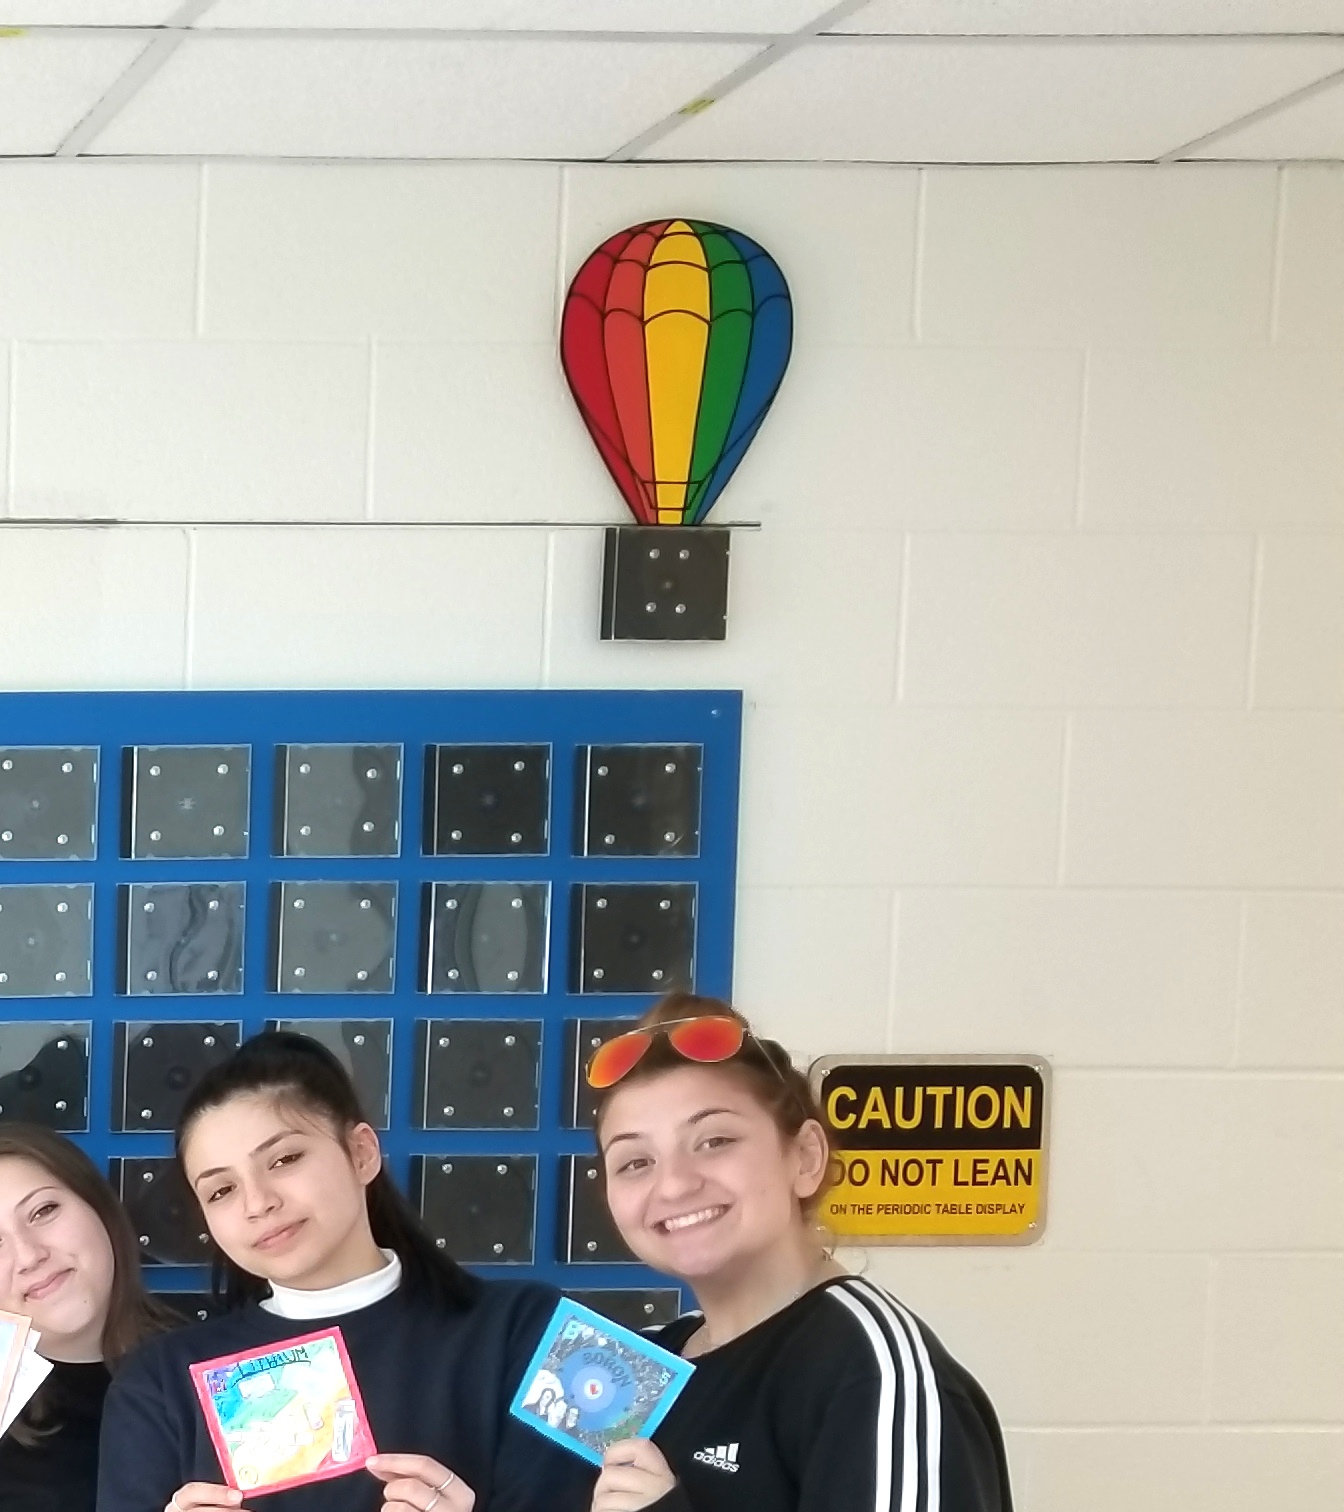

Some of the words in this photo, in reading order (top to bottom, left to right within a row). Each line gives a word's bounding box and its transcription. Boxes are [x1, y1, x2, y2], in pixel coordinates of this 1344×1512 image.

[827, 1085, 1033, 1129] CAUTION
[880, 1158, 944, 1187] NOT
[953, 1158, 1033, 1187] LEAN
[830, 1203, 847, 1215] ON
[851, 1203, 873, 1215] THE
[876, 1203, 931, 1215] PERIODIC
[935, 1203, 973, 1215] TABLE
[976, 1203, 1025, 1215] DISPLAY
[693, 1451, 740, 1473] adidas
